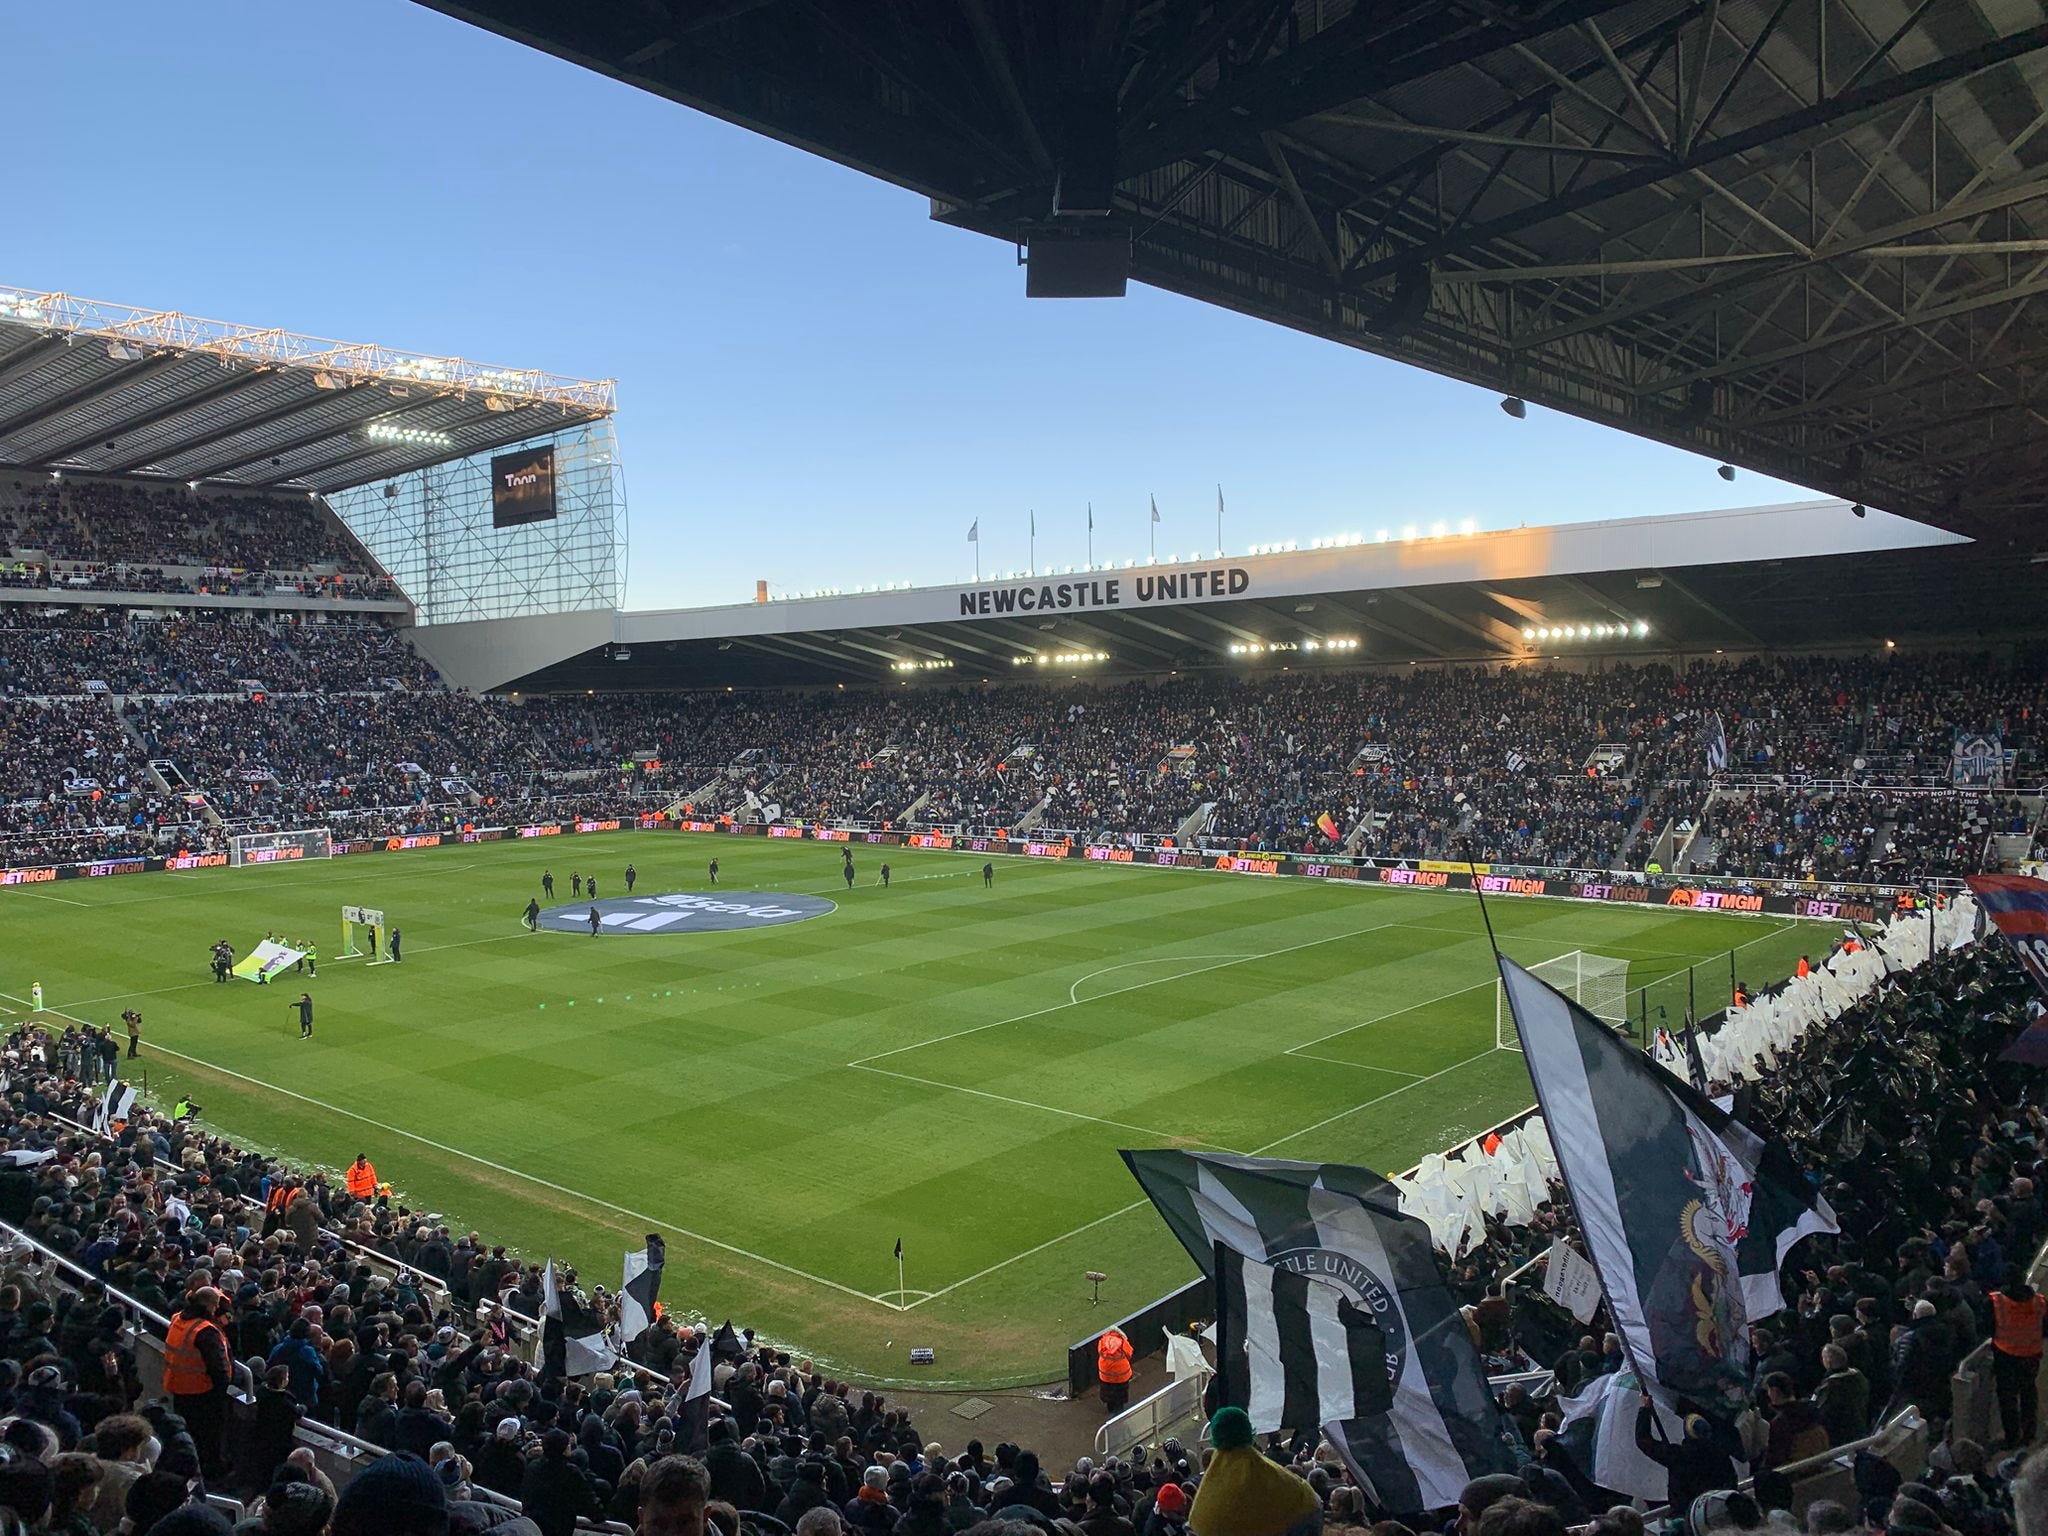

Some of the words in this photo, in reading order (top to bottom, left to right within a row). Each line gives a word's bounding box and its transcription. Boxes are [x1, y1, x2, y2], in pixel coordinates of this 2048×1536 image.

[959, 579, 1120, 616] NEWCASTLE
[1136, 568, 1250, 602] UNITED
[523, 825, 561, 838] BETMGM
[581, 820, 620, 832] BETMGM
[643, 820, 675, 830] BETMGM
[773, 826, 803, 838] BETMGM
[463, 831, 502, 843] BETMGM
[819, 830, 850, 842] BETMGM
[867, 833, 899, 845] BETMGM
[331, 842, 374, 855] BETMGM
[972, 840, 1009, 853] BETMGM
[1029, 843, 1069, 858] BETMGM
[176, 854, 228, 869] BETMGM
[256, 848, 304, 862] BETMGM
[1091, 848, 1134, 862] BETMGM
[1158, 853, 1202, 868] BETMGM
[89, 861, 145, 877] BETMGM
[1306, 864, 1360, 880] BETMGM
[1391, 869, 1449, 887] BETMGM
[1482, 876, 1546, 895] BETMGM
[1782, 882, 1818, 891] BETMGM
[1829, 884, 1867, 894] BETMGM
[1582, 884, 1650, 902] BETMGM
[1806, 900, 1875, 923] BETMGM
[1324, 1256, 1389, 1313] UNITED
